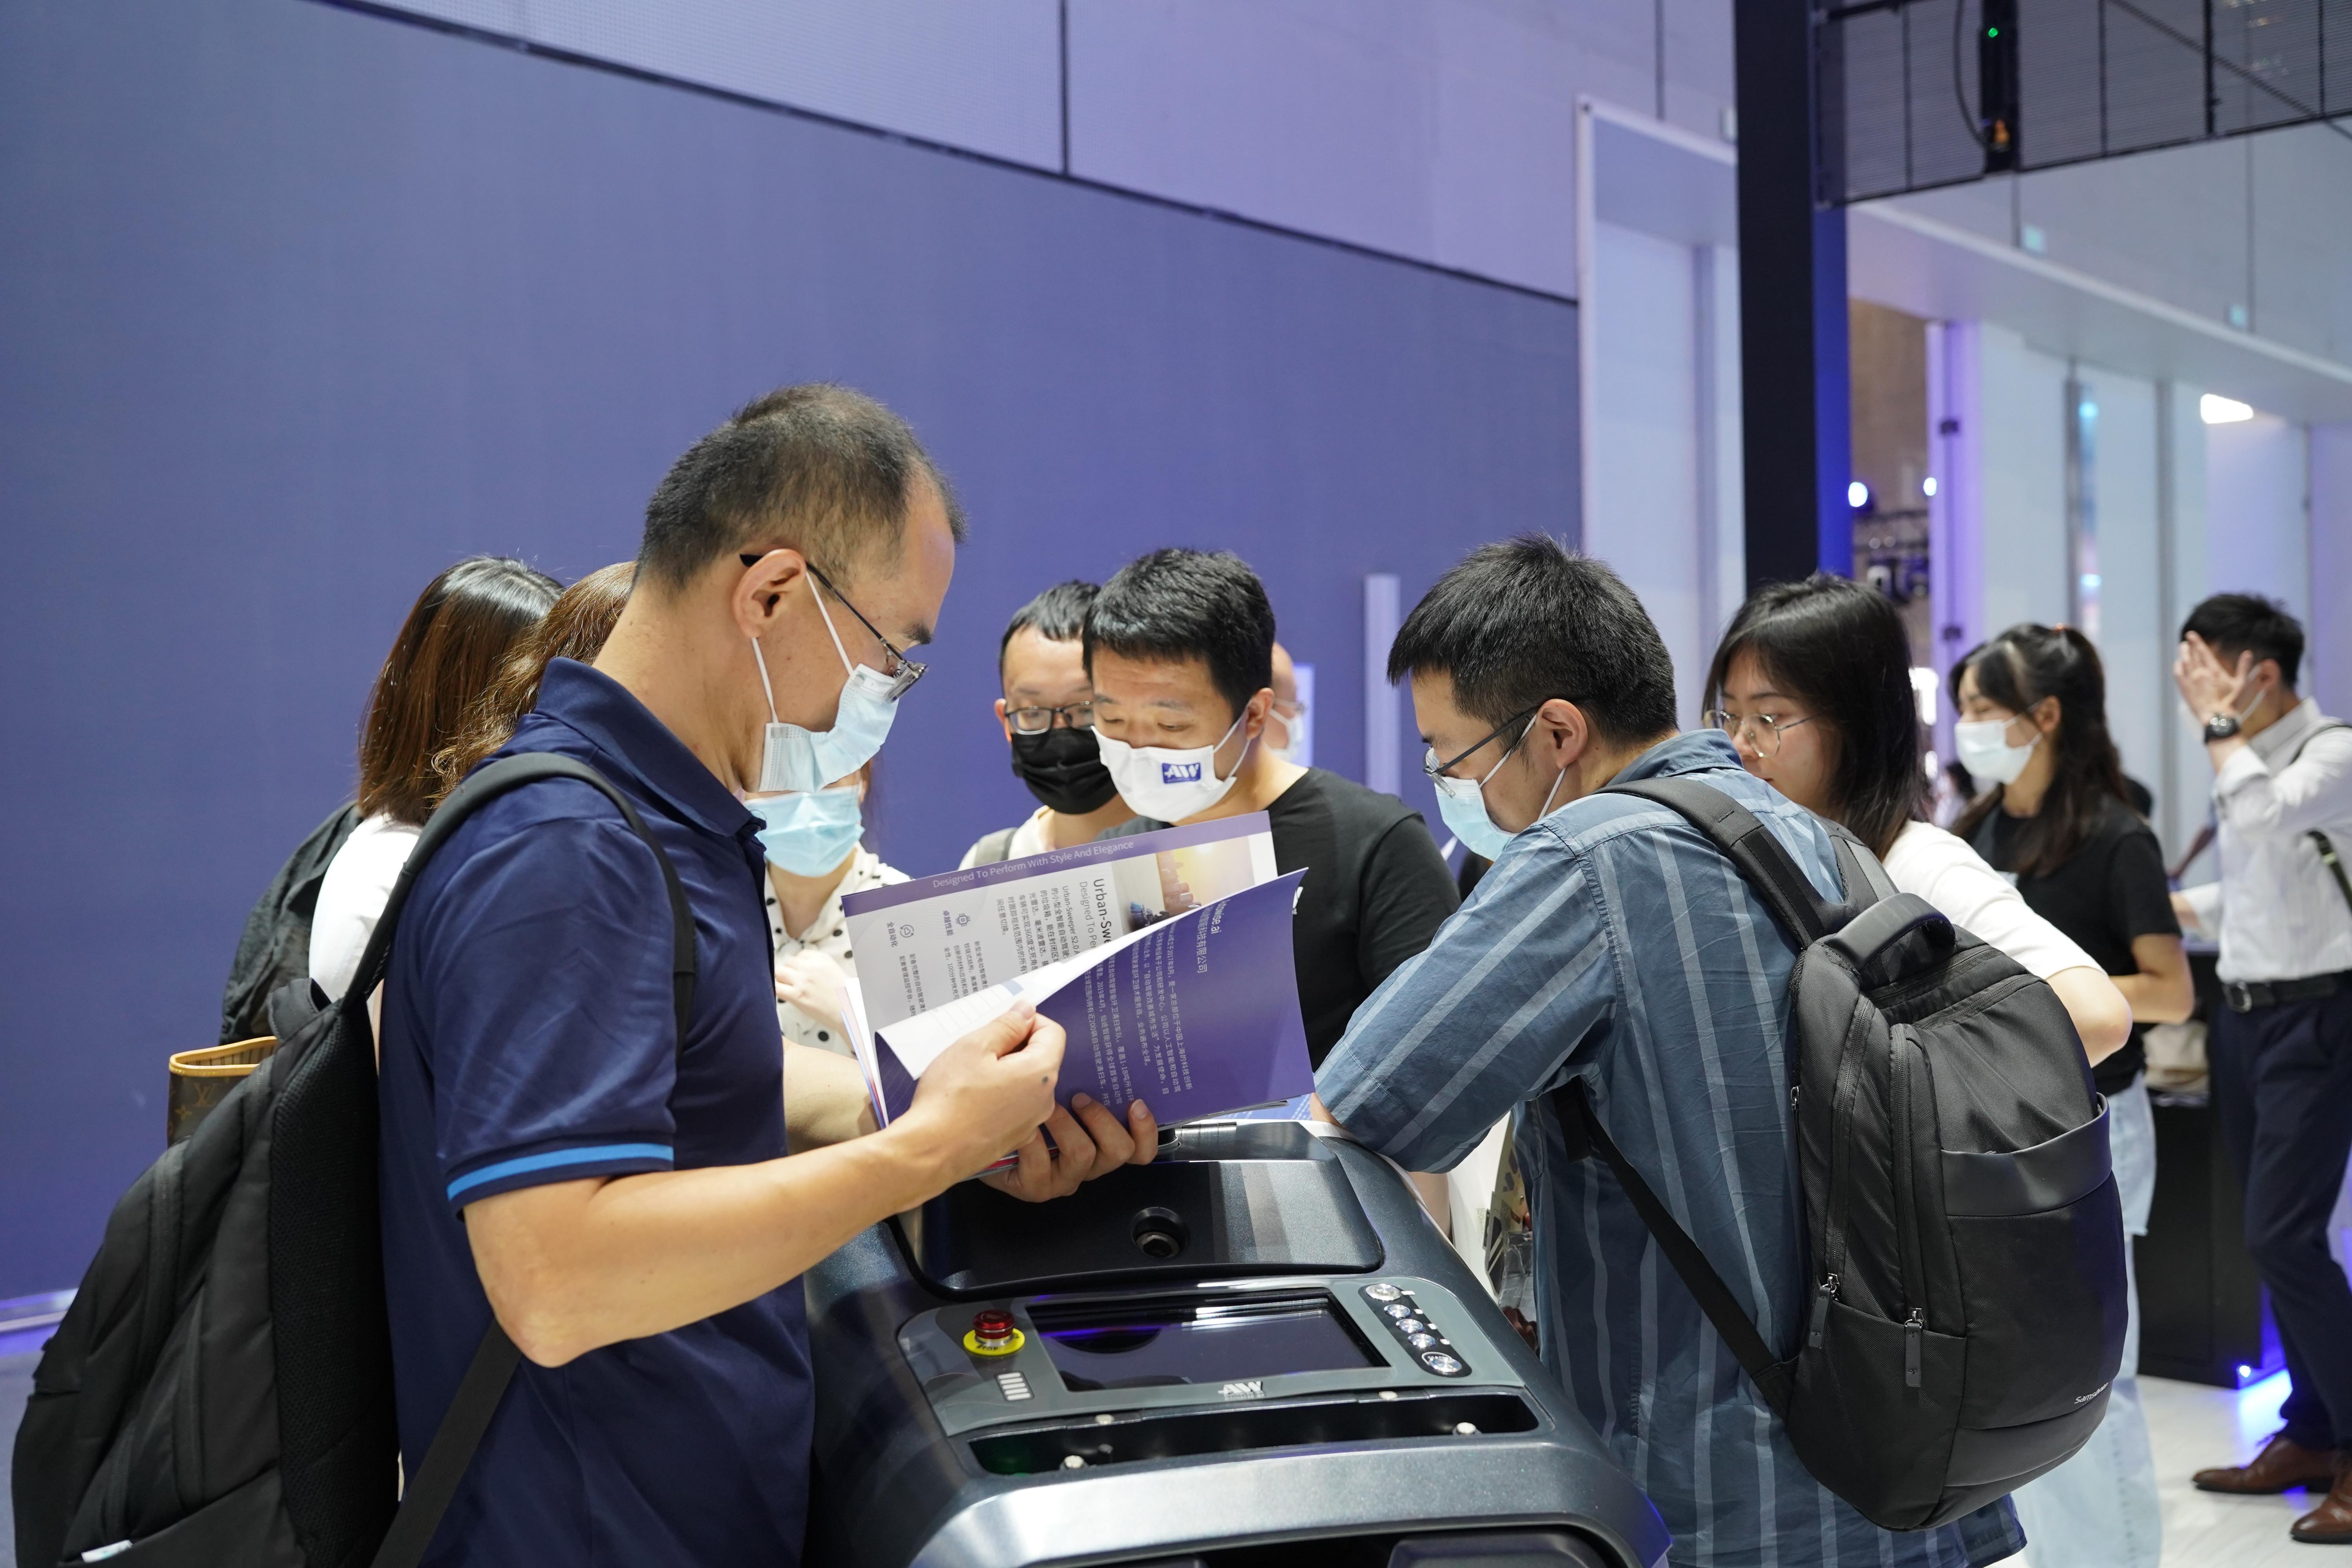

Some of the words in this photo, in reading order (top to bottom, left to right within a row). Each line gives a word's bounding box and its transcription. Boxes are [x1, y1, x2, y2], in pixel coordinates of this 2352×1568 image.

[933, 872, 974, 888] Designed
[990, 863, 1026, 876] Perform
[1027, 858, 1048, 867] With
[1050, 853, 1072, 864] Style
[1074, 848, 1092, 858] And
[1094, 842, 1134, 855] Elegance
[943, 911, 954, 936] 卓越性能
[1051, 888, 1069, 958] 的小型全智能自动驾驶
[1062, 886, 1076, 935] Urban-Sweeper
[1080, 882, 1094, 920] Designed
[1087, 922, 1095, 933] To
[887, 922, 898, 947] 全自动化
[1008, 896, 1027, 975] 时跟踪视线范围内的所有
